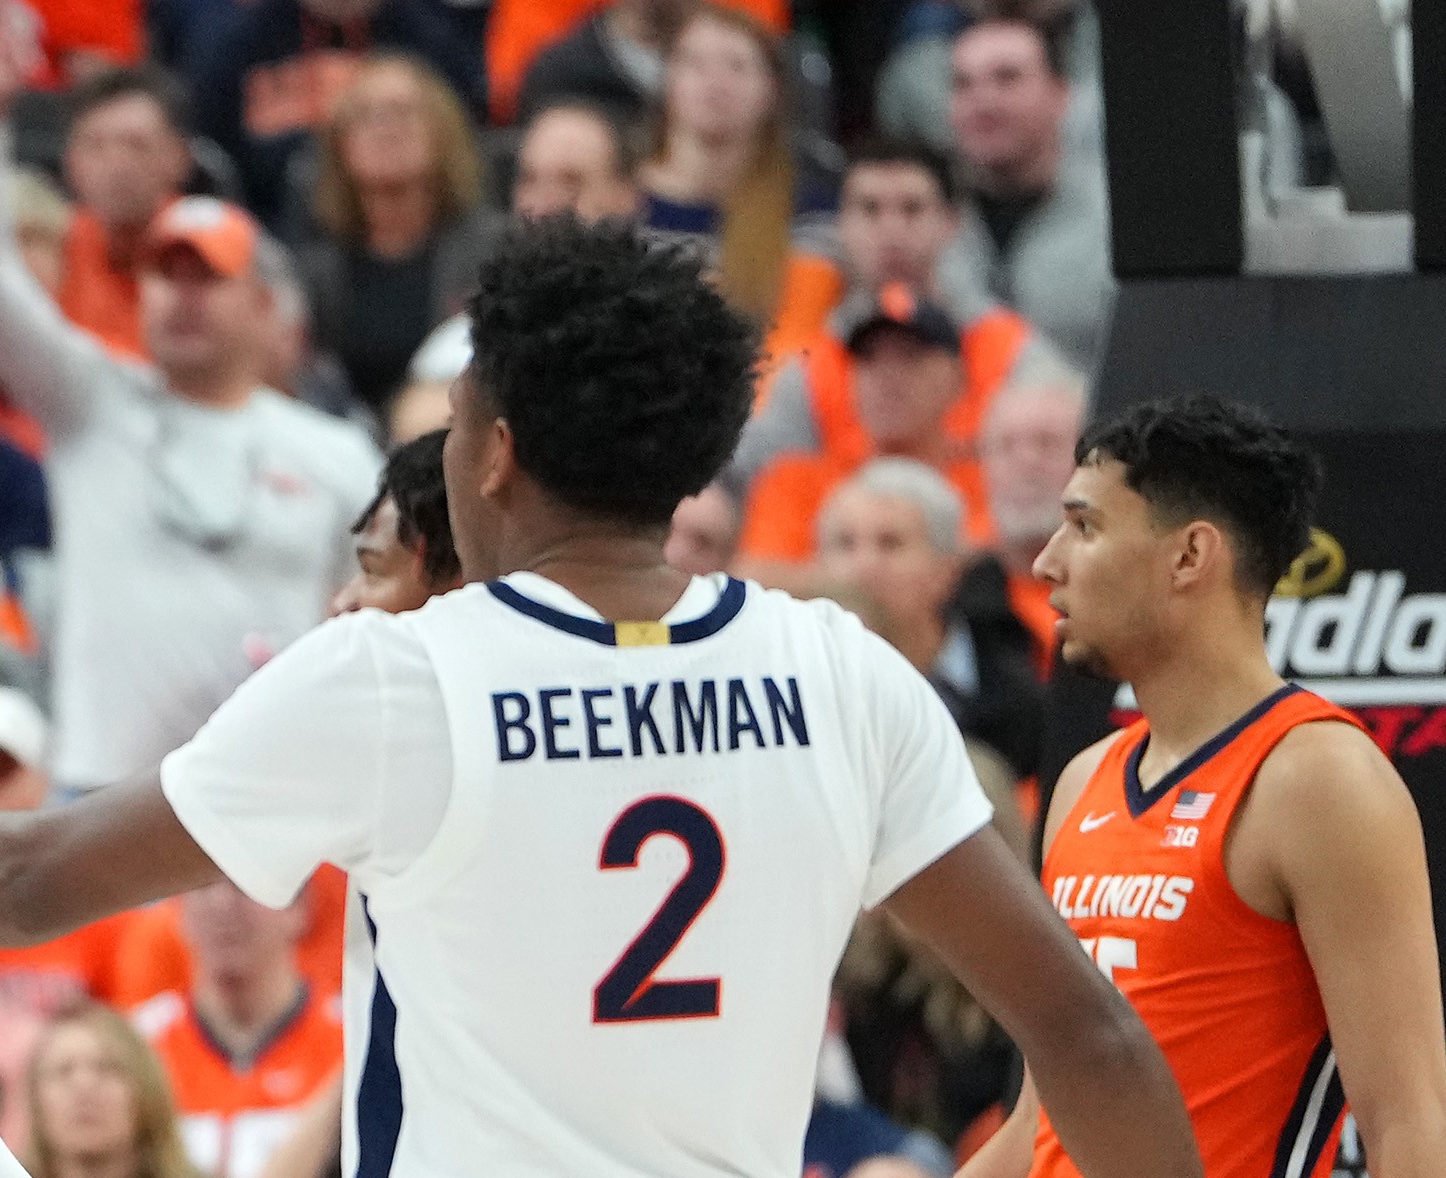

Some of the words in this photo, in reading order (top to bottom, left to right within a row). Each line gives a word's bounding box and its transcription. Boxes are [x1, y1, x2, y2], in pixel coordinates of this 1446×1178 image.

[490, 676, 811, 764] BEEKMAN
[591, 792, 727, 1025] 2
[1052, 873, 1196, 922] ILLINOIS
